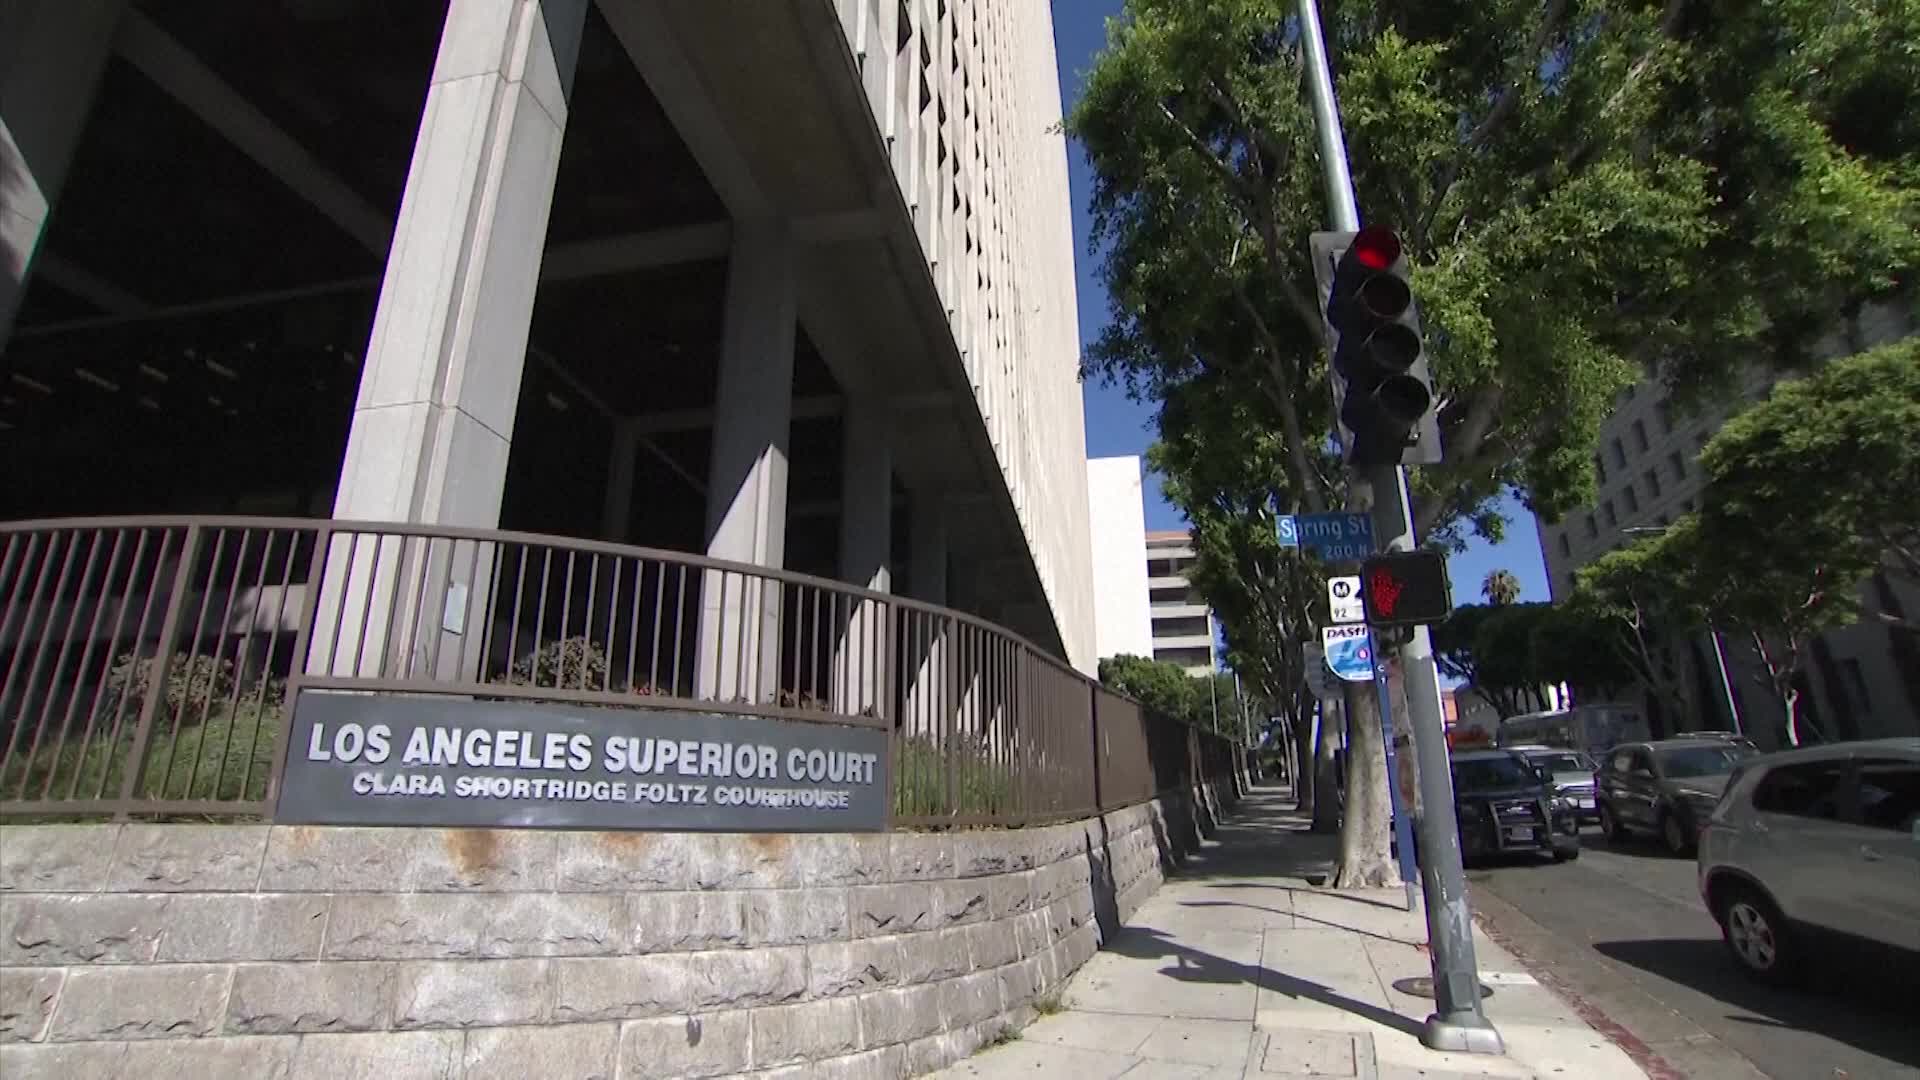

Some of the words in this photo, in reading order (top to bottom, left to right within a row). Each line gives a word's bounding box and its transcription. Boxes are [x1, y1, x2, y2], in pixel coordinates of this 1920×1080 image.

[1279, 518, 1343, 541] Spring
[1347, 515, 1368, 536] St
[1327, 544, 1353, 558] 200
[1334, 607, 1347, 618] 92
[1327, 627, 1366, 638] DASH
[308, 723, 392, 763] LOS
[402, 726, 592, 771] ANGELES
[604, 735, 778, 779] SUPERIOR
[787, 747, 877, 784] COURT
[353, 772, 446, 796] CLARA
[455, 775, 627, 801] SHORTRIDGE
[634, 782, 707, 804] FOLTZ
[714, 786, 849, 810] COURTHOUSE
